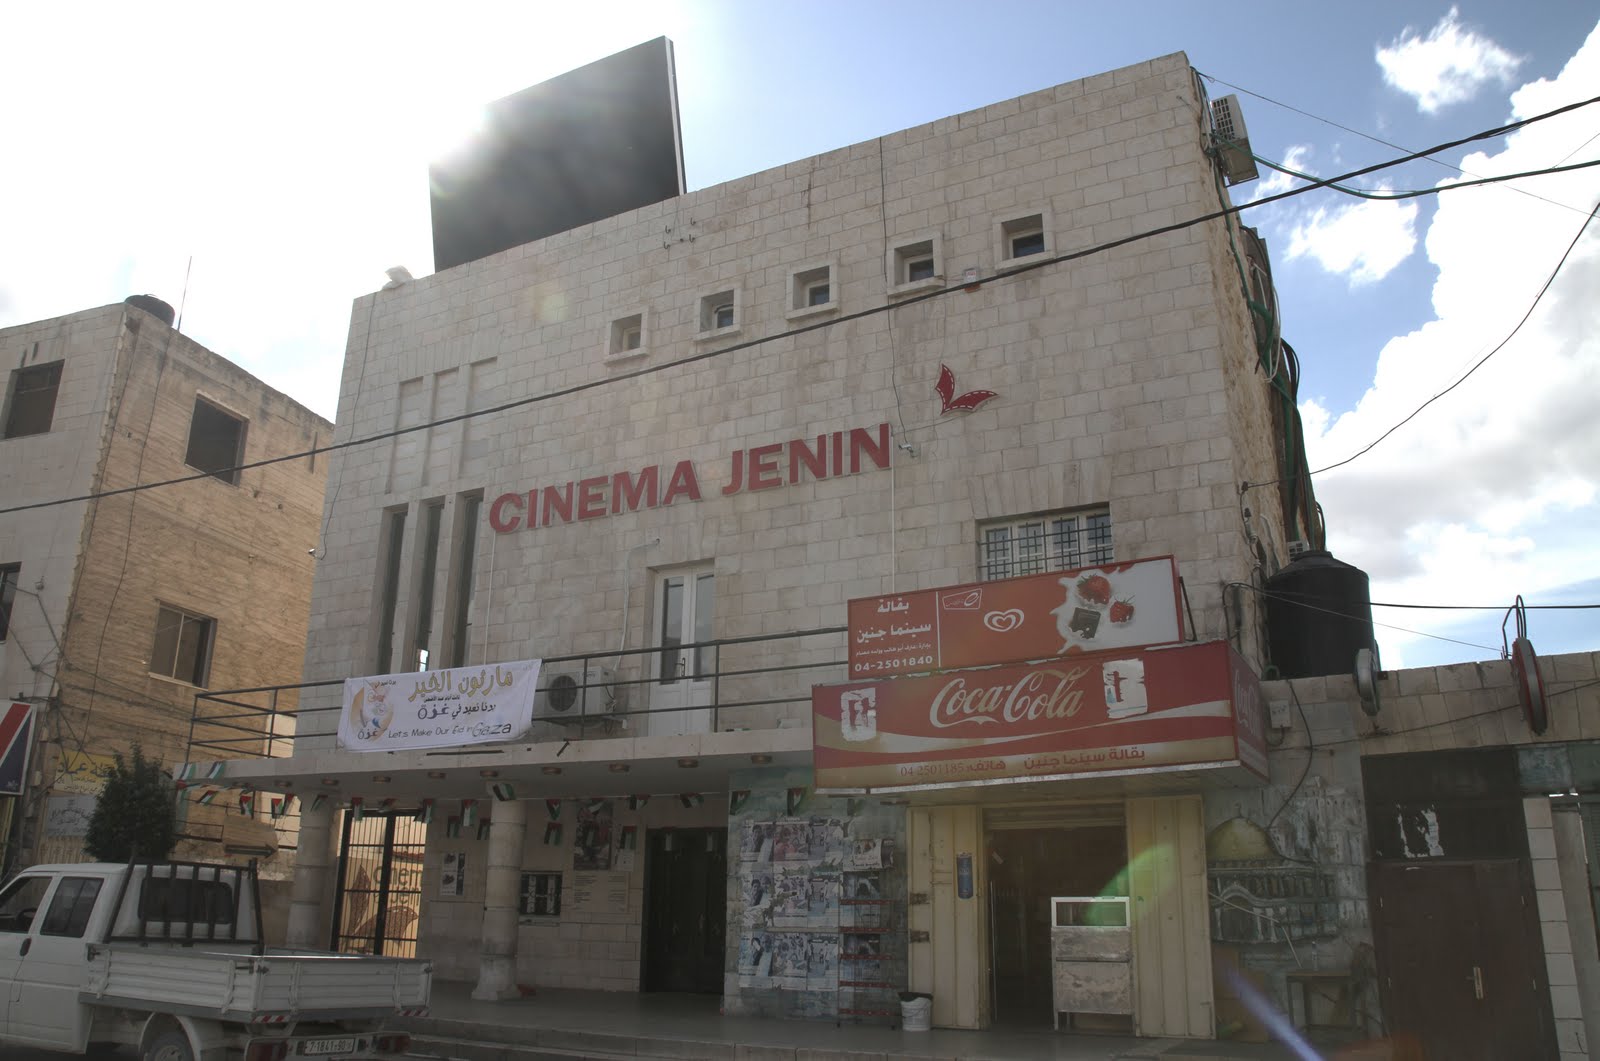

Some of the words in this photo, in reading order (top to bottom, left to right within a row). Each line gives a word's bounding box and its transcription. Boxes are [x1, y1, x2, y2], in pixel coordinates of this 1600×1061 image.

[489, 459, 702, 534] CINEMA
[722, 422, 892, 496] JENIN
[877, 597, 910, 615] بقالة
[856, 626, 887, 643] جنين
[890, 621, 932, 638] سينما
[854, 655, 933, 672] 04-2501840
[929, 665, 1092, 728] Coca-Cola
[417, 703, 450, 720] غزة
[411, 728, 432, 737] Make
[435, 726, 450, 735] Our
[472, 722, 512, 737] Gaza
[1063, 752, 1106, 765] سينما
[1109, 747, 1146, 761] بقالة
[1023, 756, 1060, 770] جنين
